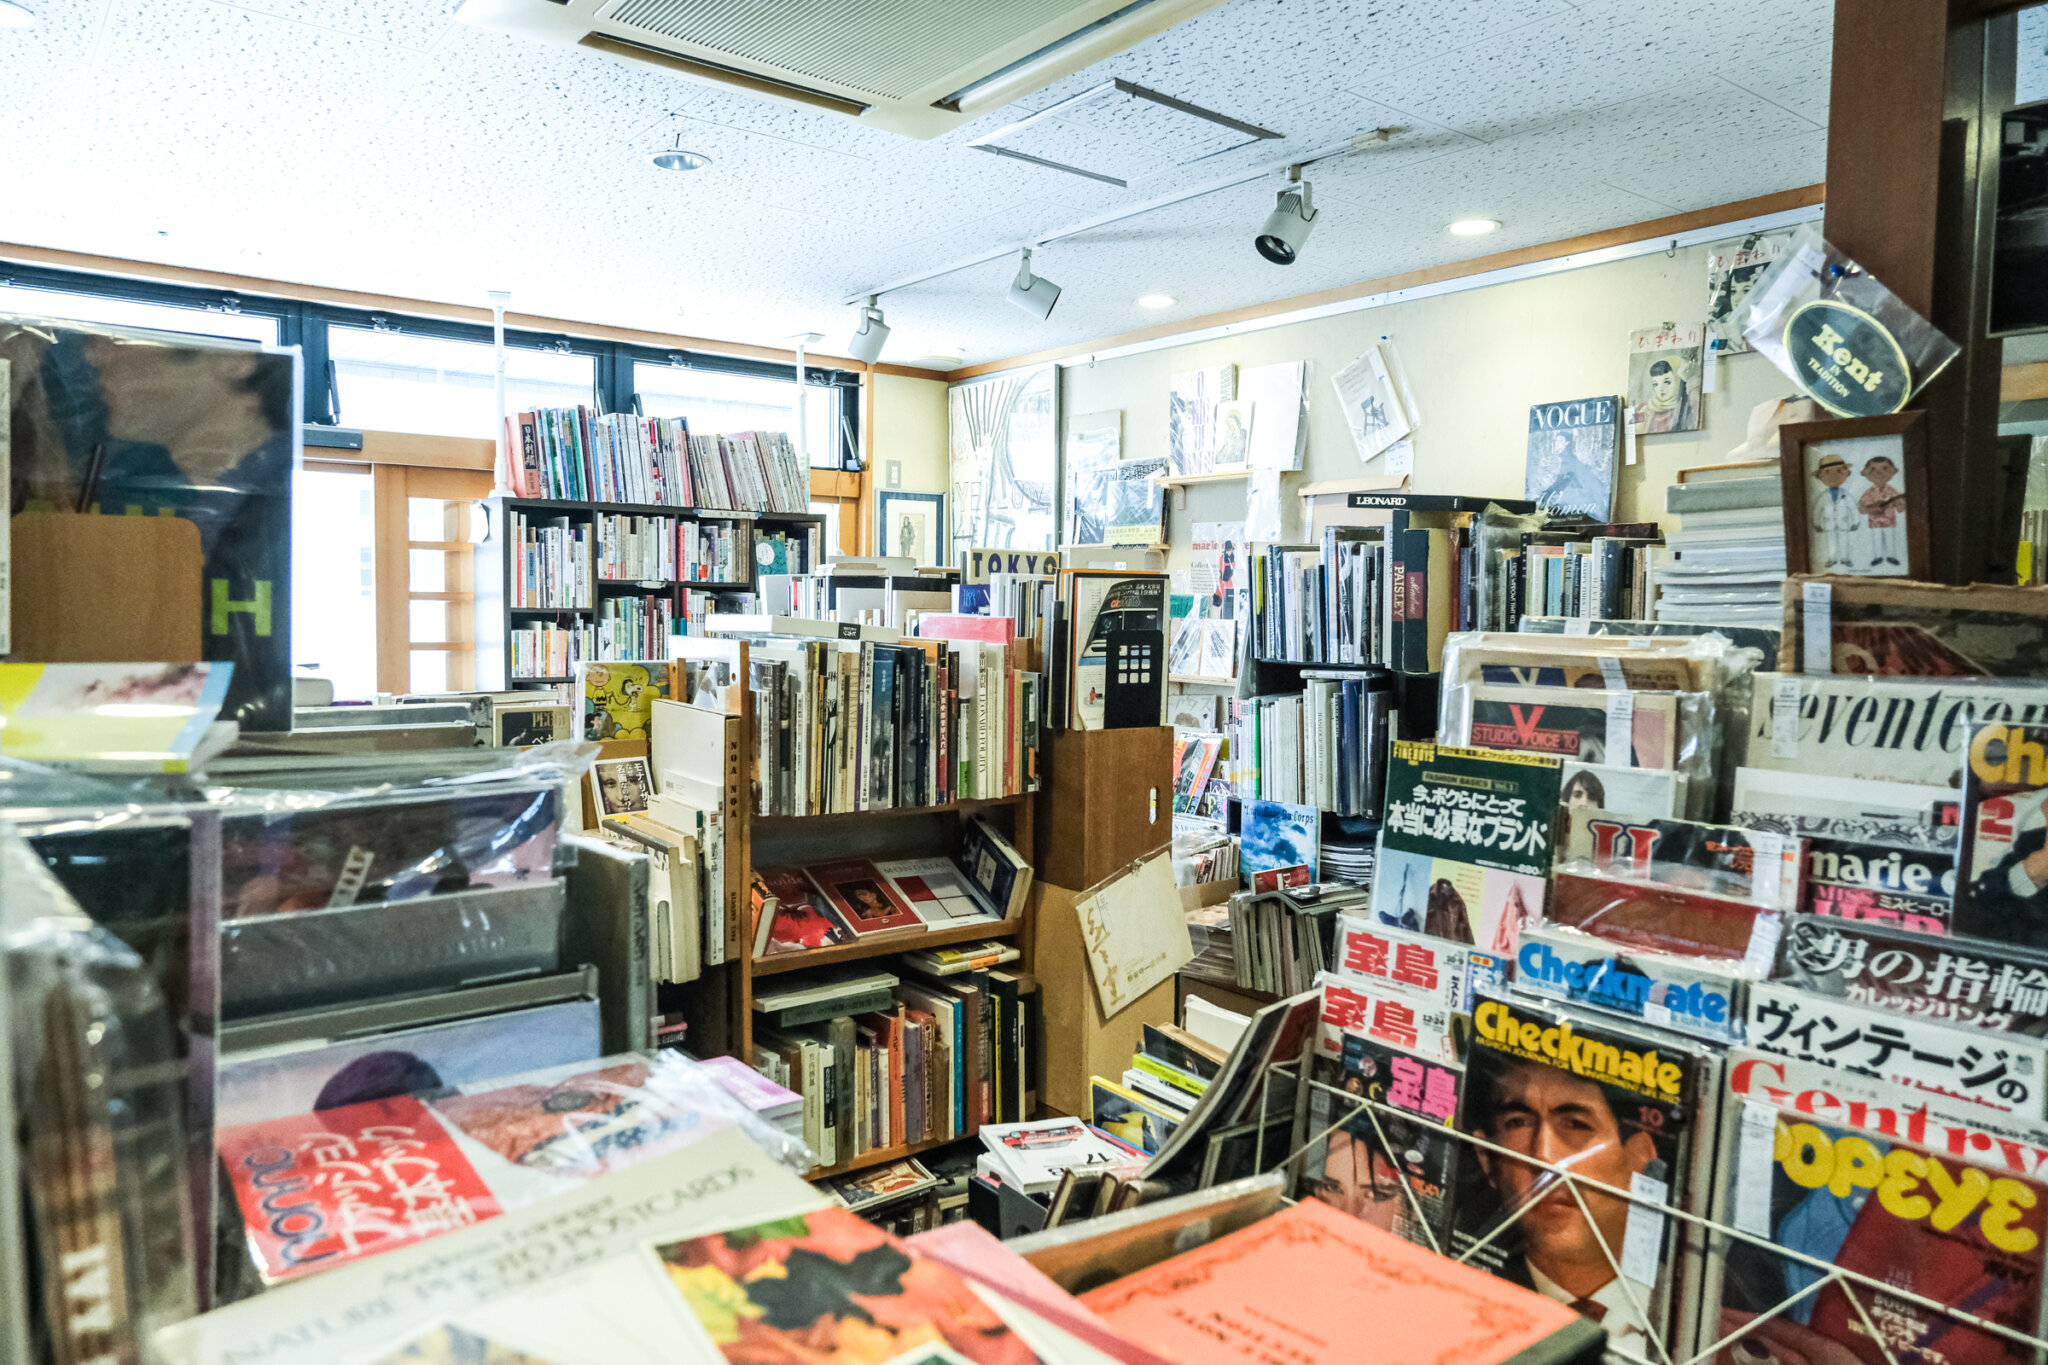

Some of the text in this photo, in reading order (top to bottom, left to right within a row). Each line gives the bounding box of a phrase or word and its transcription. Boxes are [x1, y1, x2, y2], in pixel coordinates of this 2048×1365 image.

[1638, 332, 1697, 349] ひまわり
[1811, 323, 1884, 392] Kent
[1807, 357, 1850, 397] TRADITION
[1535, 400, 1611, 430] VOGUE
[1356, 496, 1407, 506] LEONARD
[973, 552, 1058, 578] TOKYO
[1393, 566, 1405, 618] PAISLEY
[1472, 726, 1519, 743] STUDIO
[1509, 703, 1561, 747] VOICE
[730, 741, 738, 818] NOA NOA
[1424, 771, 1458, 783] FASHION
[1459, 777, 1489, 789] BASICS
[1969, 723, 2048, 786] Ch
[1412, 784, 1526, 817] 今、ボクらにとって
[1387, 800, 1548, 856] 本当に必要なブランド
[1808, 849, 1933, 894] marie
[1344, 931, 1439, 991] 宝島
[1824, 929, 2048, 1017] 男の指輪
[1321, 985, 1418, 1049] 宝島
[1846, 983, 2011, 1031] カレッジリング
[1474, 1001, 1683, 1096] Checkmate
[1756, 999, 2029, 1104] ヴィンテージの
[1387, 1056, 1457, 1121] 宝島
[1639, 1105, 1665, 1127] 10
[299, 1130, 409, 1254] ファッション
